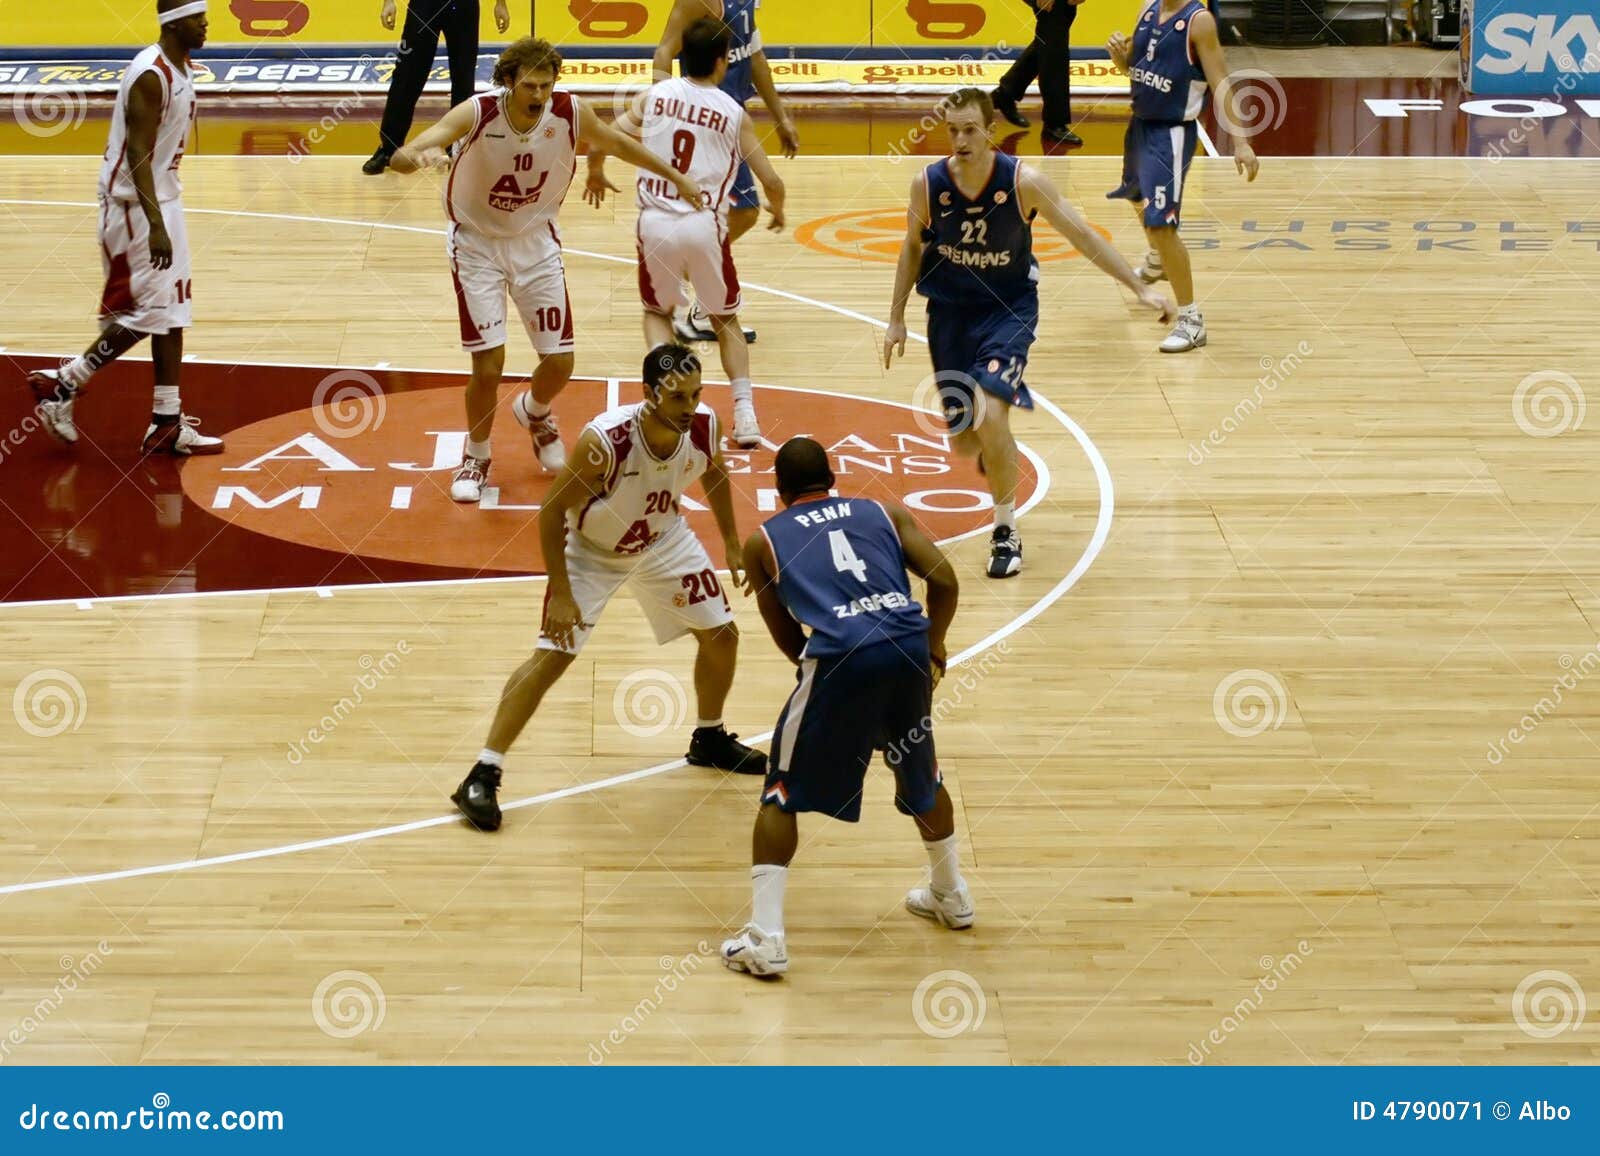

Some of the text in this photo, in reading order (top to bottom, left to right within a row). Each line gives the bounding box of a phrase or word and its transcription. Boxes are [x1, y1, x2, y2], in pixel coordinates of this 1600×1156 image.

[37, 66, 125, 84] Twis
[224, 64, 366, 82] PEPSI
[560, 63, 647, 75] abelli
[863, 64, 985, 84] gabelli
[653, 97, 729, 134] BULLERI
[513, 153, 533, 172] 10
[671, 129, 695, 174] 9
[490, 171, 549, 196] AJ
[638, 176, 712, 206] MILO
[1155, 186, 1166, 209] 5
[961, 219, 987, 246] 22
[937, 245, 1010, 269] SIEMENS
[536, 306, 561, 332] 10
[644, 490, 672, 515] 20
[794, 503, 851, 527] PENN
[828, 529, 868, 582] 4
[682, 568, 720, 605] 20
